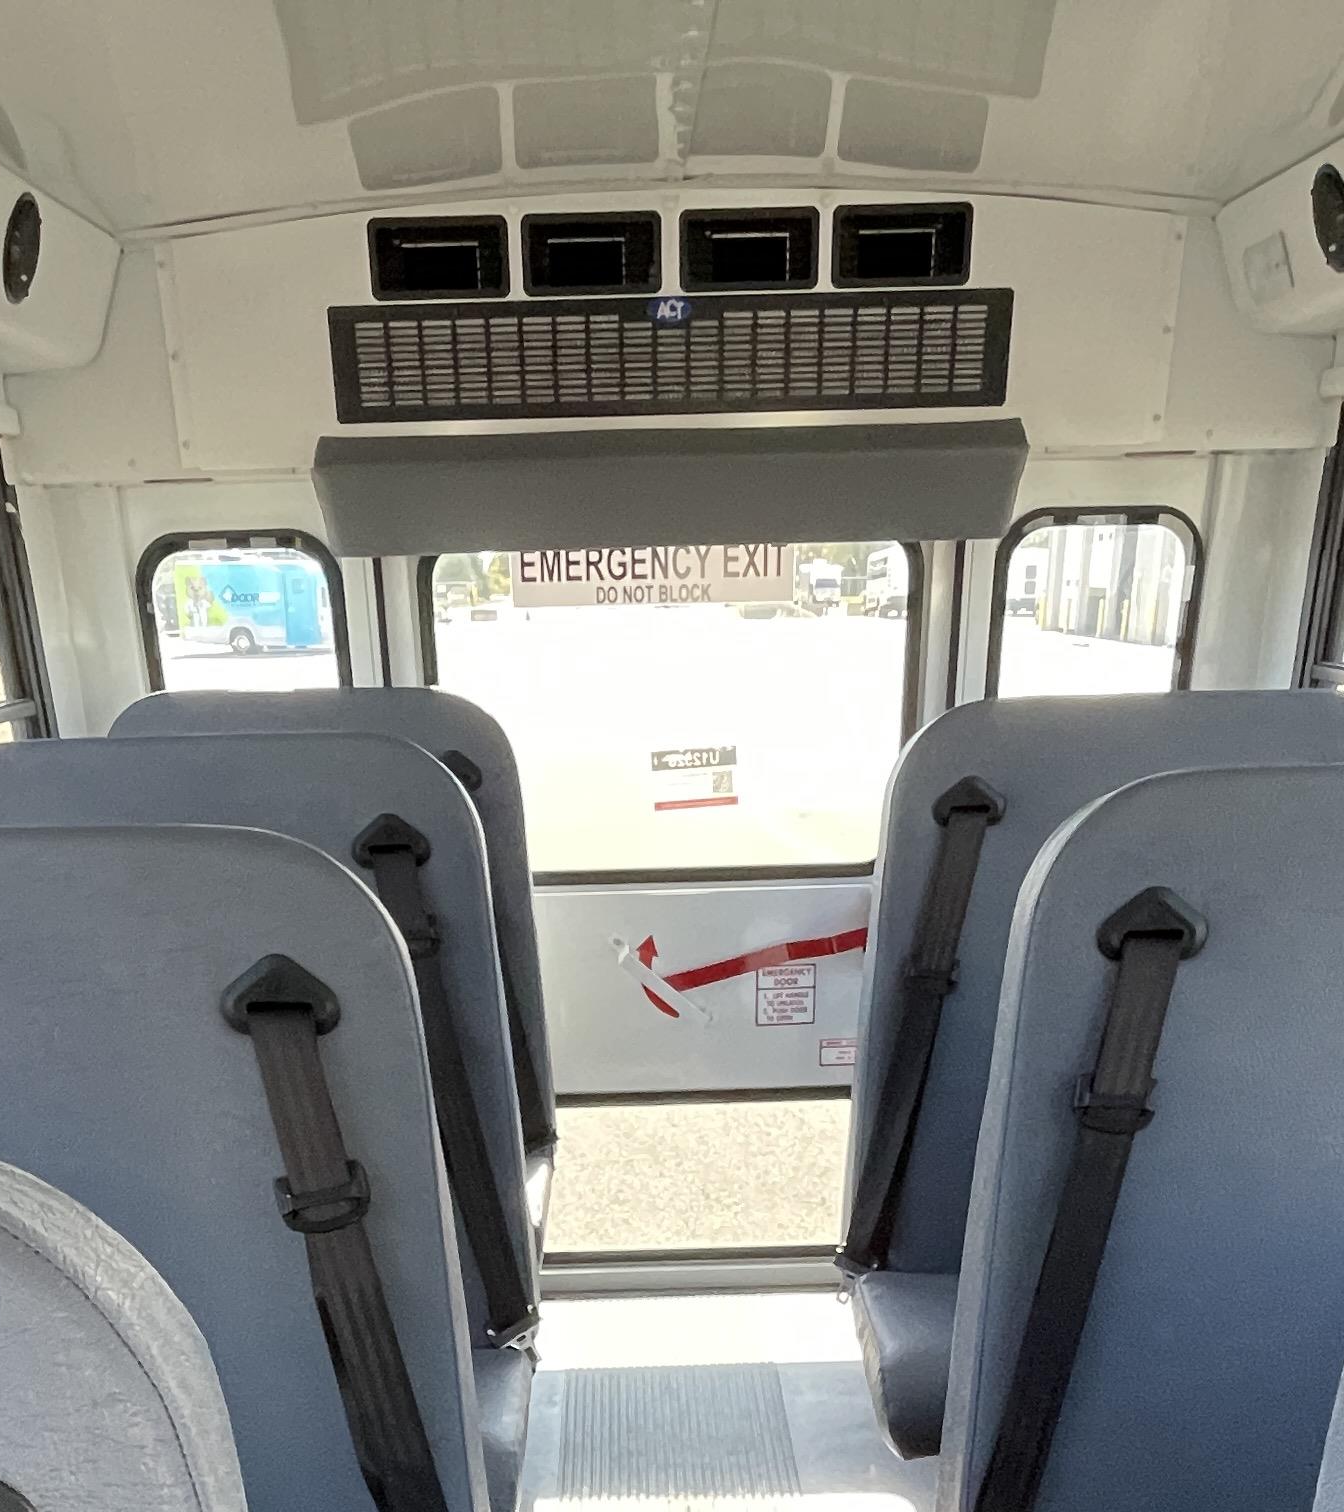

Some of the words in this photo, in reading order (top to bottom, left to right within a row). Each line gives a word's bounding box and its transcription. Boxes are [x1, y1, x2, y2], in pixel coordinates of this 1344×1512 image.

[656, 299, 685, 320] ACT
[520, 545, 713, 583] EMERGENCY
[722, 543, 787, 578] EXIT
[596, 586, 618, 604] DO
[623, 585, 654, 603] NOT
[658, 583, 712, 602] BLOCK
